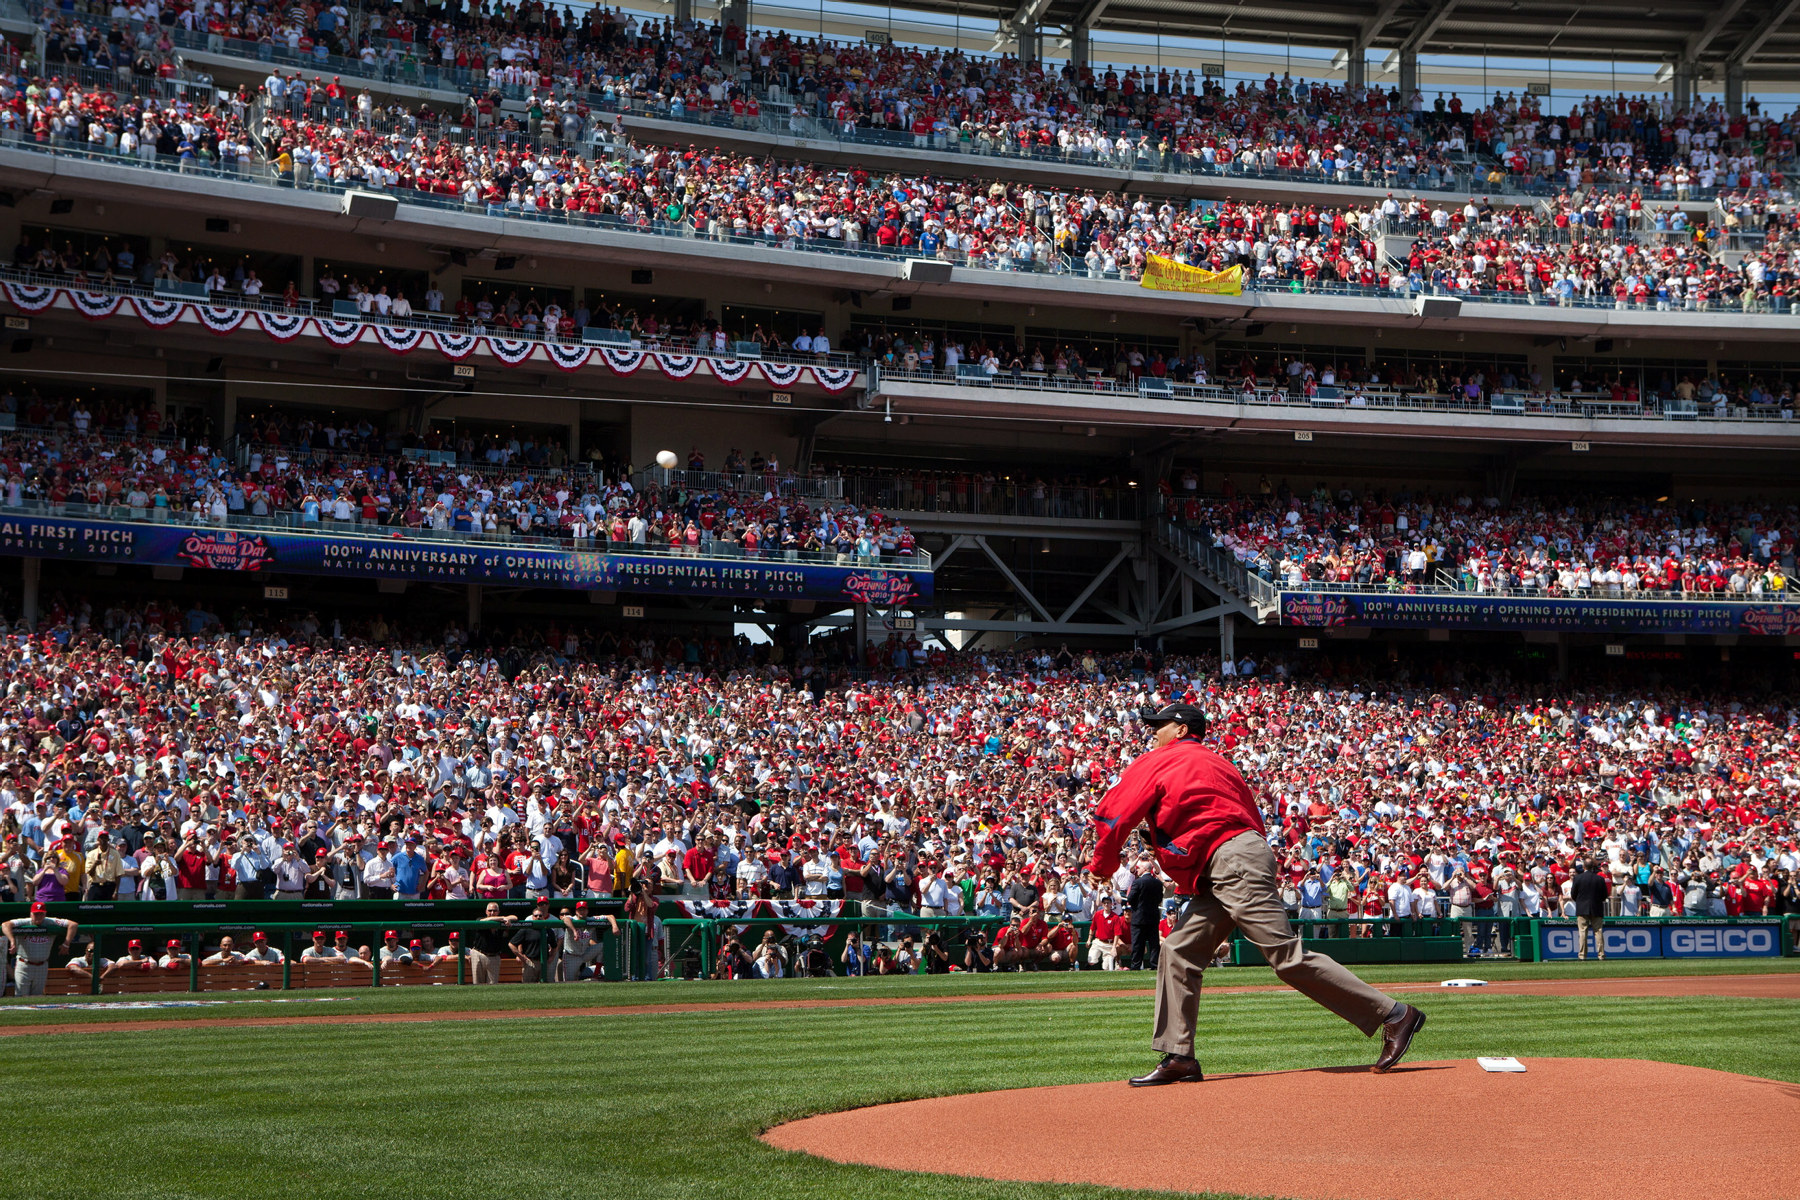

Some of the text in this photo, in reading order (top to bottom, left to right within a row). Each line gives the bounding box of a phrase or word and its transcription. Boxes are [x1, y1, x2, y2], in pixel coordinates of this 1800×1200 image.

[870, 34, 885, 42] 405
[457, 367, 472, 375] 207
[775, 394, 789, 402] 206
[1297, 432, 1310, 440] 205
[30, 524, 77, 539] FIRST
[84, 528, 134, 543] PITCH
[58, 541, 75, 553] 5,
[88, 543, 132, 555] 2010
[185, 537, 268, 558] OPENING DAY
[215, 556, 237, 564] 2010
[323, 544, 804, 582] 100TH ANNIVERSARY of OPENING DAY PRESIDENTIAL FIRST PITCH
[323, 559, 416, 573] NATIONALS
[428, 565, 467, 576] PARK
[633, 577, 650, 585] DC
[691, 579, 734, 590] APRIL
[744, 582, 758, 592] 5,
[769, 583, 804, 592] 2010
[846, 577, 913, 593] OPENING DAY
[268, 588, 285, 598] 115
[870, 591, 888, 599] 2010
[626, 608, 641, 616] 114
[1285, 601, 1348, 615] OPENING DAY
[1363, 601, 1731, 618] 100TH ANNIVERSARY of OPENING DAY PRESIDENTIAL FIRST PITCH
[1363, 613, 1432, 621] NATIONALS
[1744, 611, 1783, 623] OPENING
[1302, 639, 1316, 647] 112
[1608, 646, 1621, 654] 111
[1547, 929, 1652, 953] GECO
[1670, 928, 1772, 953] GEICO
